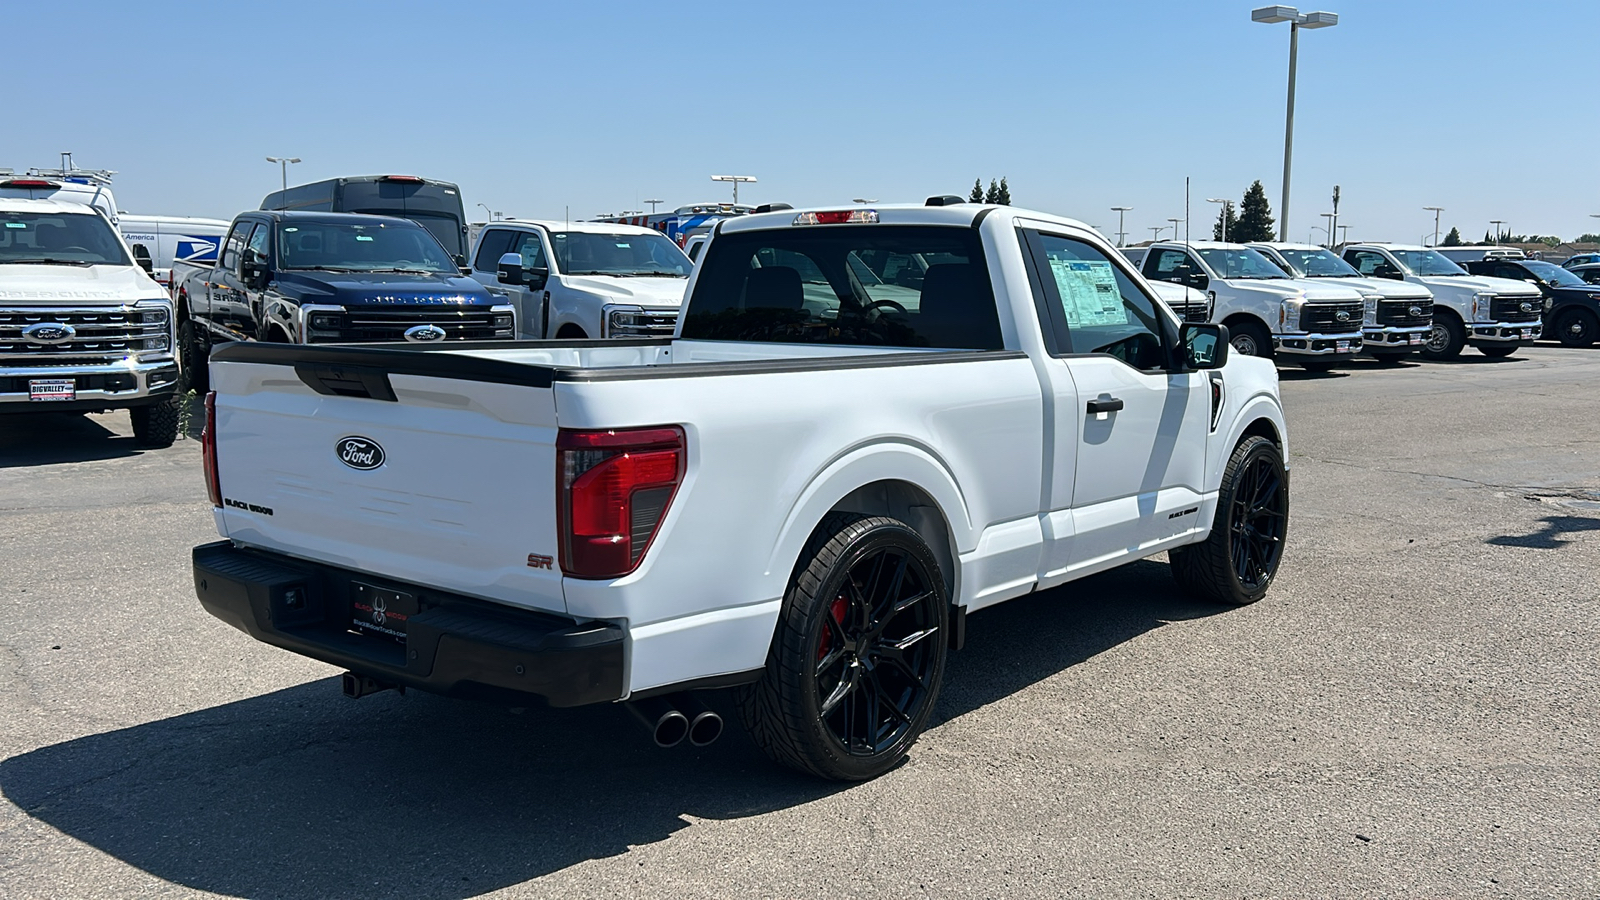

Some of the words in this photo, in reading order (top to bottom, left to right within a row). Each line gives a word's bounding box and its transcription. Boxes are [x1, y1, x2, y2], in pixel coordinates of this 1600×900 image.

[125, 233, 155, 241] America
[224, 498, 249, 511] BLACK
[248, 503, 274, 516] WIDOW
[527, 552, 554, 571] SR
